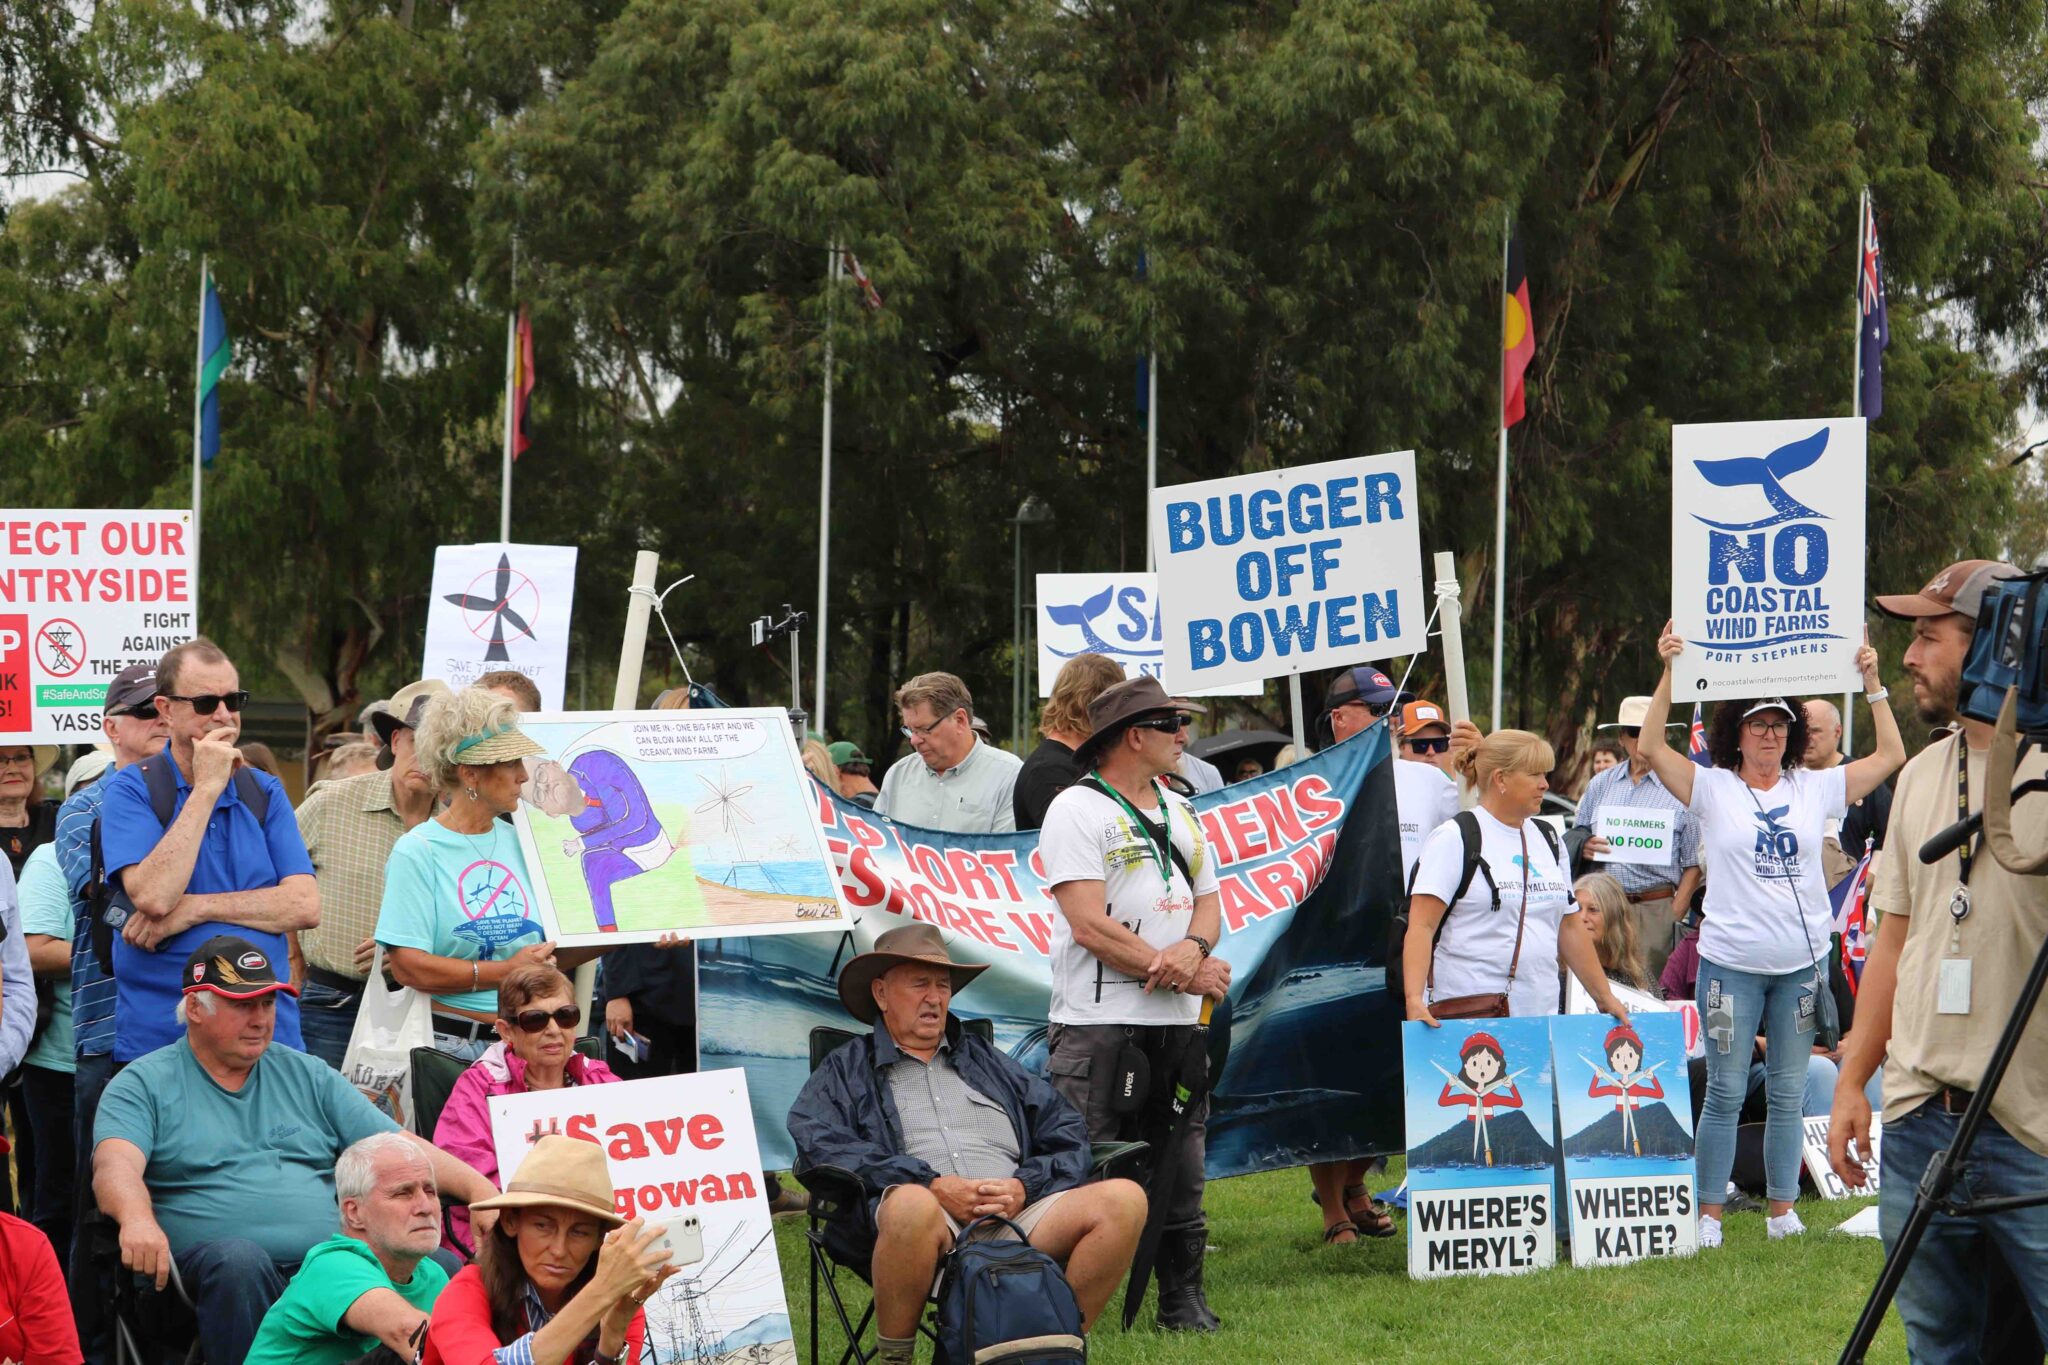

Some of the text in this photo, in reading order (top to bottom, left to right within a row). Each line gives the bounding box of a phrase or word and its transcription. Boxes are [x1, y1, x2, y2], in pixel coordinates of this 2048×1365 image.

[1166, 472, 1403, 554] BUGGER
[0, 521, 186, 556] ECT OUR
[1708, 523, 1829, 586] NO
[1236, 538, 1342, 601] OFF
[1706, 586, 1830, 614] COASTAL
[144, 613, 190, 628] FIGHT
[1188, 589, 1400, 671] BOWEN
[1706, 614, 1829, 639] WIND FARMS
[446, 658, 472, 673] SAVE
[1706, 643, 1828, 663] PORT STEPHENS
[90, 659, 121, 675] THE
[1712, 673, 1837, 687] nocoastalwindfarmsportstephens
[42, 687, 107, 702] #SafeAndSo
[51, 713, 101, 732] YASS
[633, 724, 649, 733] JOIN
[650, 724, 661, 732] ME
[676, 723, 691, 732] ONE
[693, 723, 705, 732] BIG
[707, 722, 725, 731] FART
[727, 721, 742, 730] AND
[743, 721, 755, 730] WE
[636, 734, 740, 744] CAN BLOW AWAY ALL OF THE
[640, 746, 719, 756] OCEANIC WIND FARMS
[1606, 817, 1666, 830] NO FARMERS
[1606, 835, 1663, 849] NO FOOD
[1755, 830, 1799, 858] NO
[1755, 865, 1775, 875] WIND
[1124, 1072, 1135, 1097] uvex
[614, 1171, 757, 1221] gowan
[1576, 1184, 1691, 1220] WHERE'S
[1416, 1194, 1547, 1233] WHERE'S
[1428, 1234, 1537, 1272] MERYL?
[1596, 1223, 1677, 1259] KATE?
